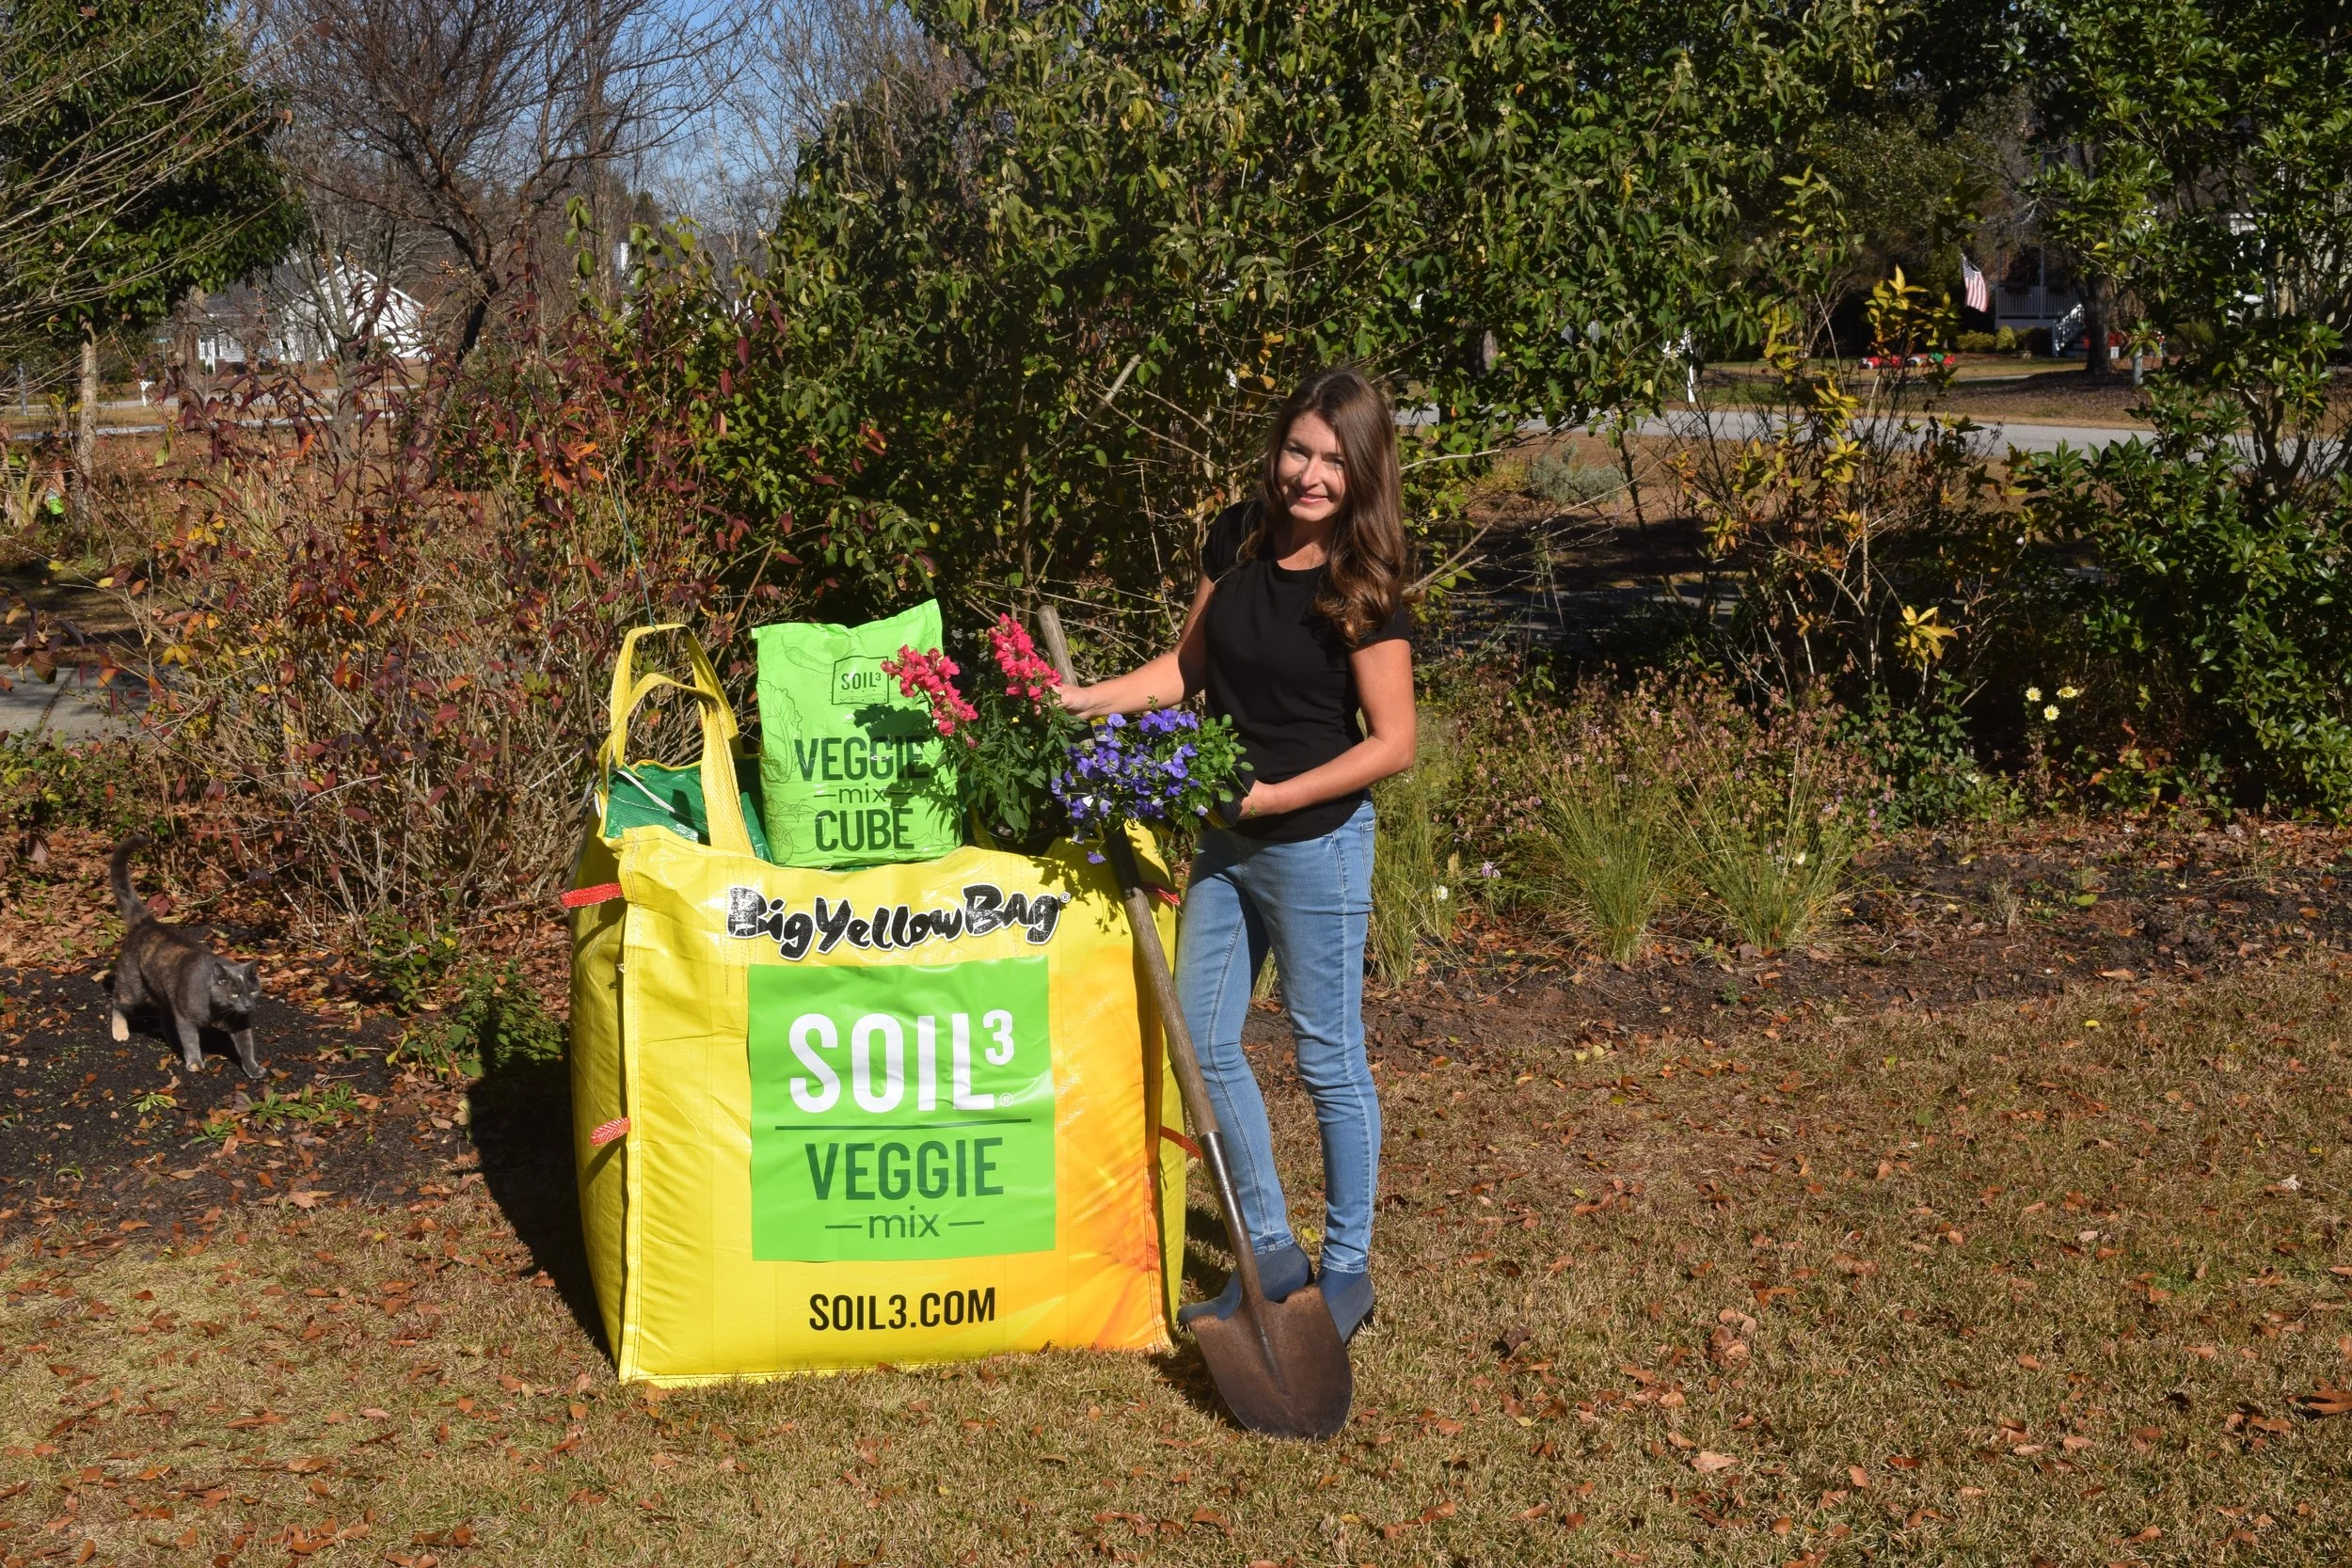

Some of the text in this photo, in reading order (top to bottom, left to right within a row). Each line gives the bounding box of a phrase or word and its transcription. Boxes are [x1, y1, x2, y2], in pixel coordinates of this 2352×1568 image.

[794, 736, 930, 782] VEGGIE
[838, 783, 887, 804] mix
[815, 807, 915, 852] CUBE
[804, 1136, 1004, 1201] VEGGIE
[868, 1205, 940, 1239] mix
[809, 1287, 995, 1332] SOIL3.COM
